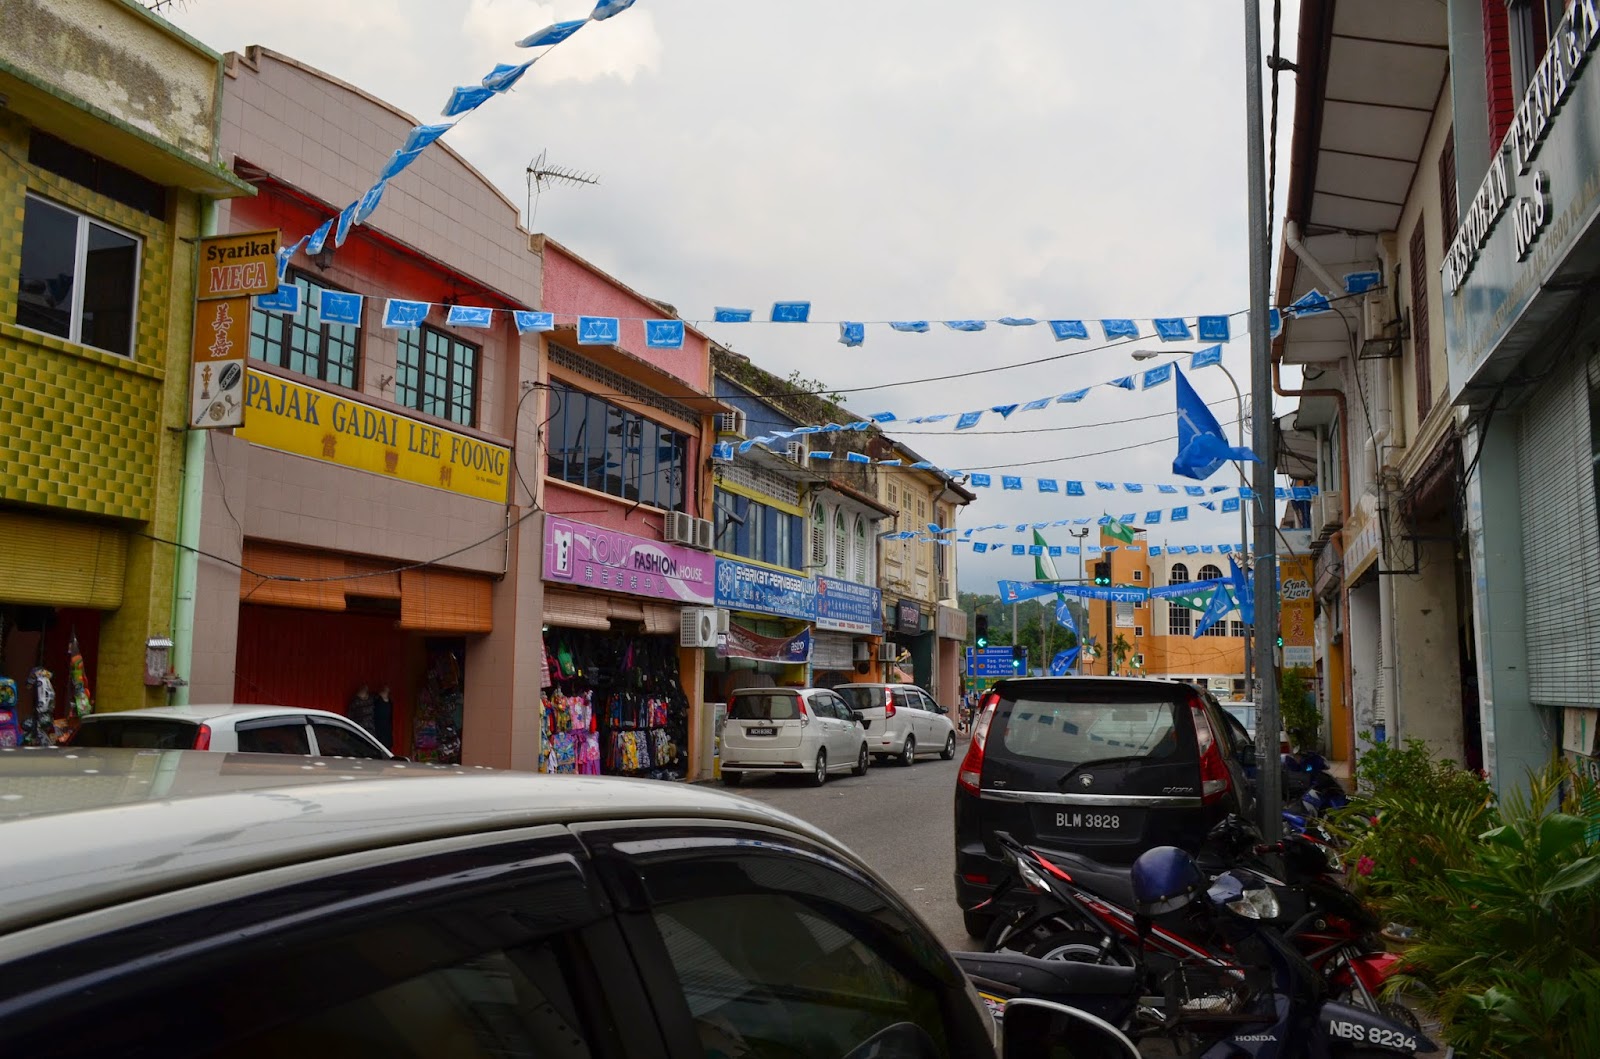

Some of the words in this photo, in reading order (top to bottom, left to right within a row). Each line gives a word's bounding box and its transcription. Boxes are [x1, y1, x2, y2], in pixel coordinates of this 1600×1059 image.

[1448, 152, 1508, 297] RESTORAN
[1513, 170, 1545, 262] No.8
[207, 239, 277, 263] Syarikat
[209, 262, 268, 293] MECA
[246, 374, 320, 426] PAJAK
[332, 401, 399, 447] GADAI
[407, 423, 442, 459] LEE
[450, 436, 505, 476] FOONG
[585, 530, 632, 568] TONY
[634, 550, 677, 576] FASHION
[679, 566, 702, 581] HOUSE
[735, 565, 769, 588] SYARIKAT
[1282, 579, 1306, 594] STAR
[1286, 589, 1311, 600] LIGHT
[790, 639, 805, 652] astro
[1056, 812, 1081, 828] BLM
[1085, 814, 1120, 829] 3828
[1329, 1019, 1365, 1041] NBS
[1368, 1027, 1417, 1051] 8234
